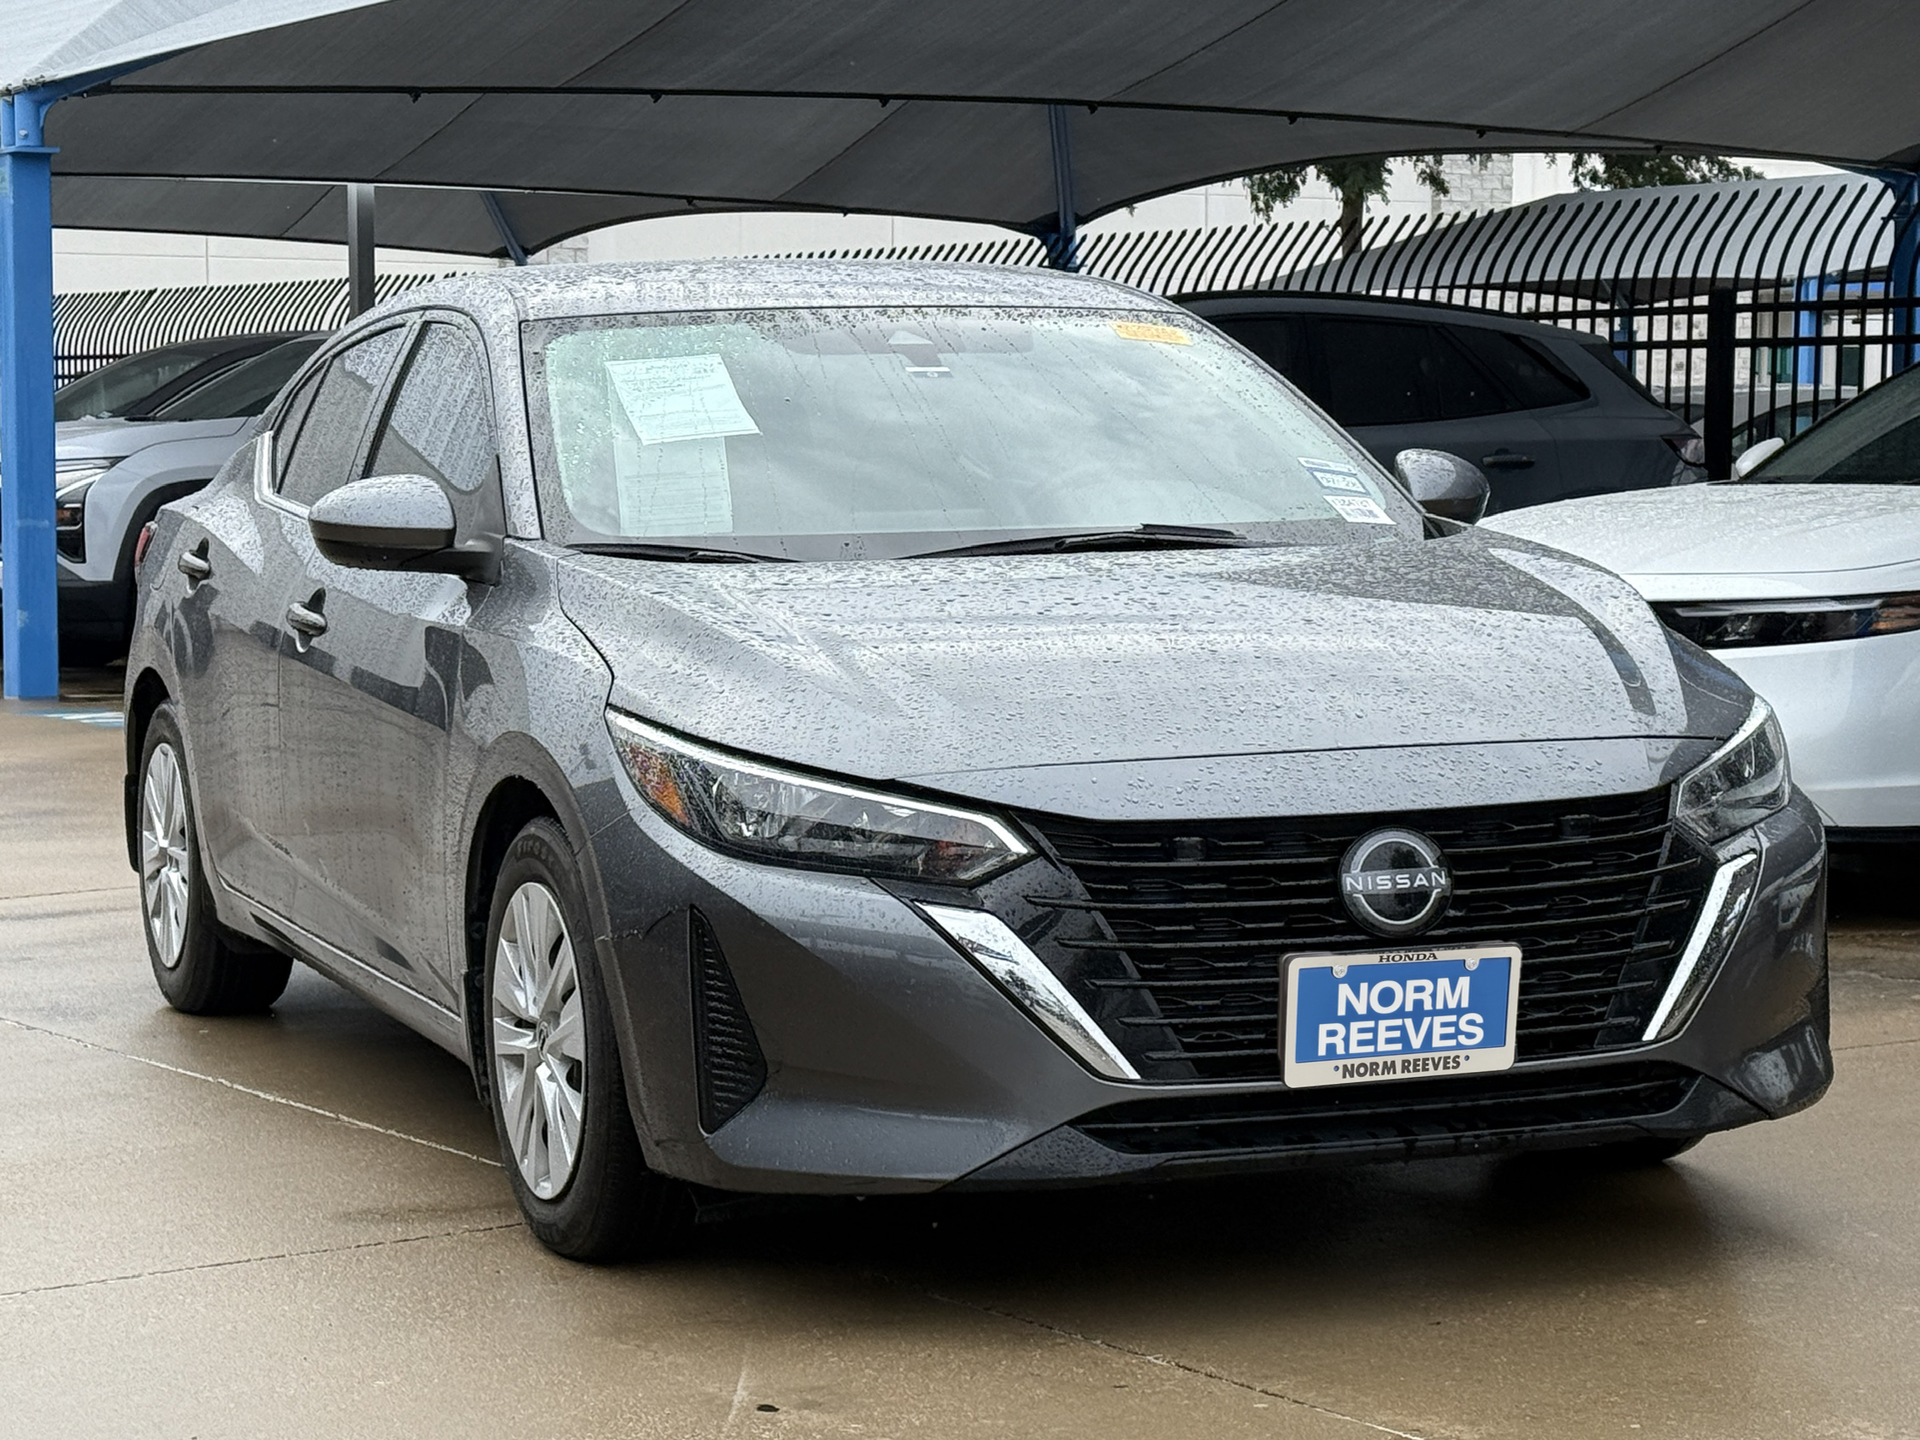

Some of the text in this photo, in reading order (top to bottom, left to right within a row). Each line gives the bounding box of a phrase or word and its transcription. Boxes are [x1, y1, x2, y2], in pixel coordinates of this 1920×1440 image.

[1345, 870, 1446, 891] NISSAN
[1377, 952, 1438, 963] HONDA
[1337, 976, 1470, 1016] NORM
[1317, 1012, 1484, 1056] REEVES
[1341, 1055, 1461, 1079] NORM REEVES
